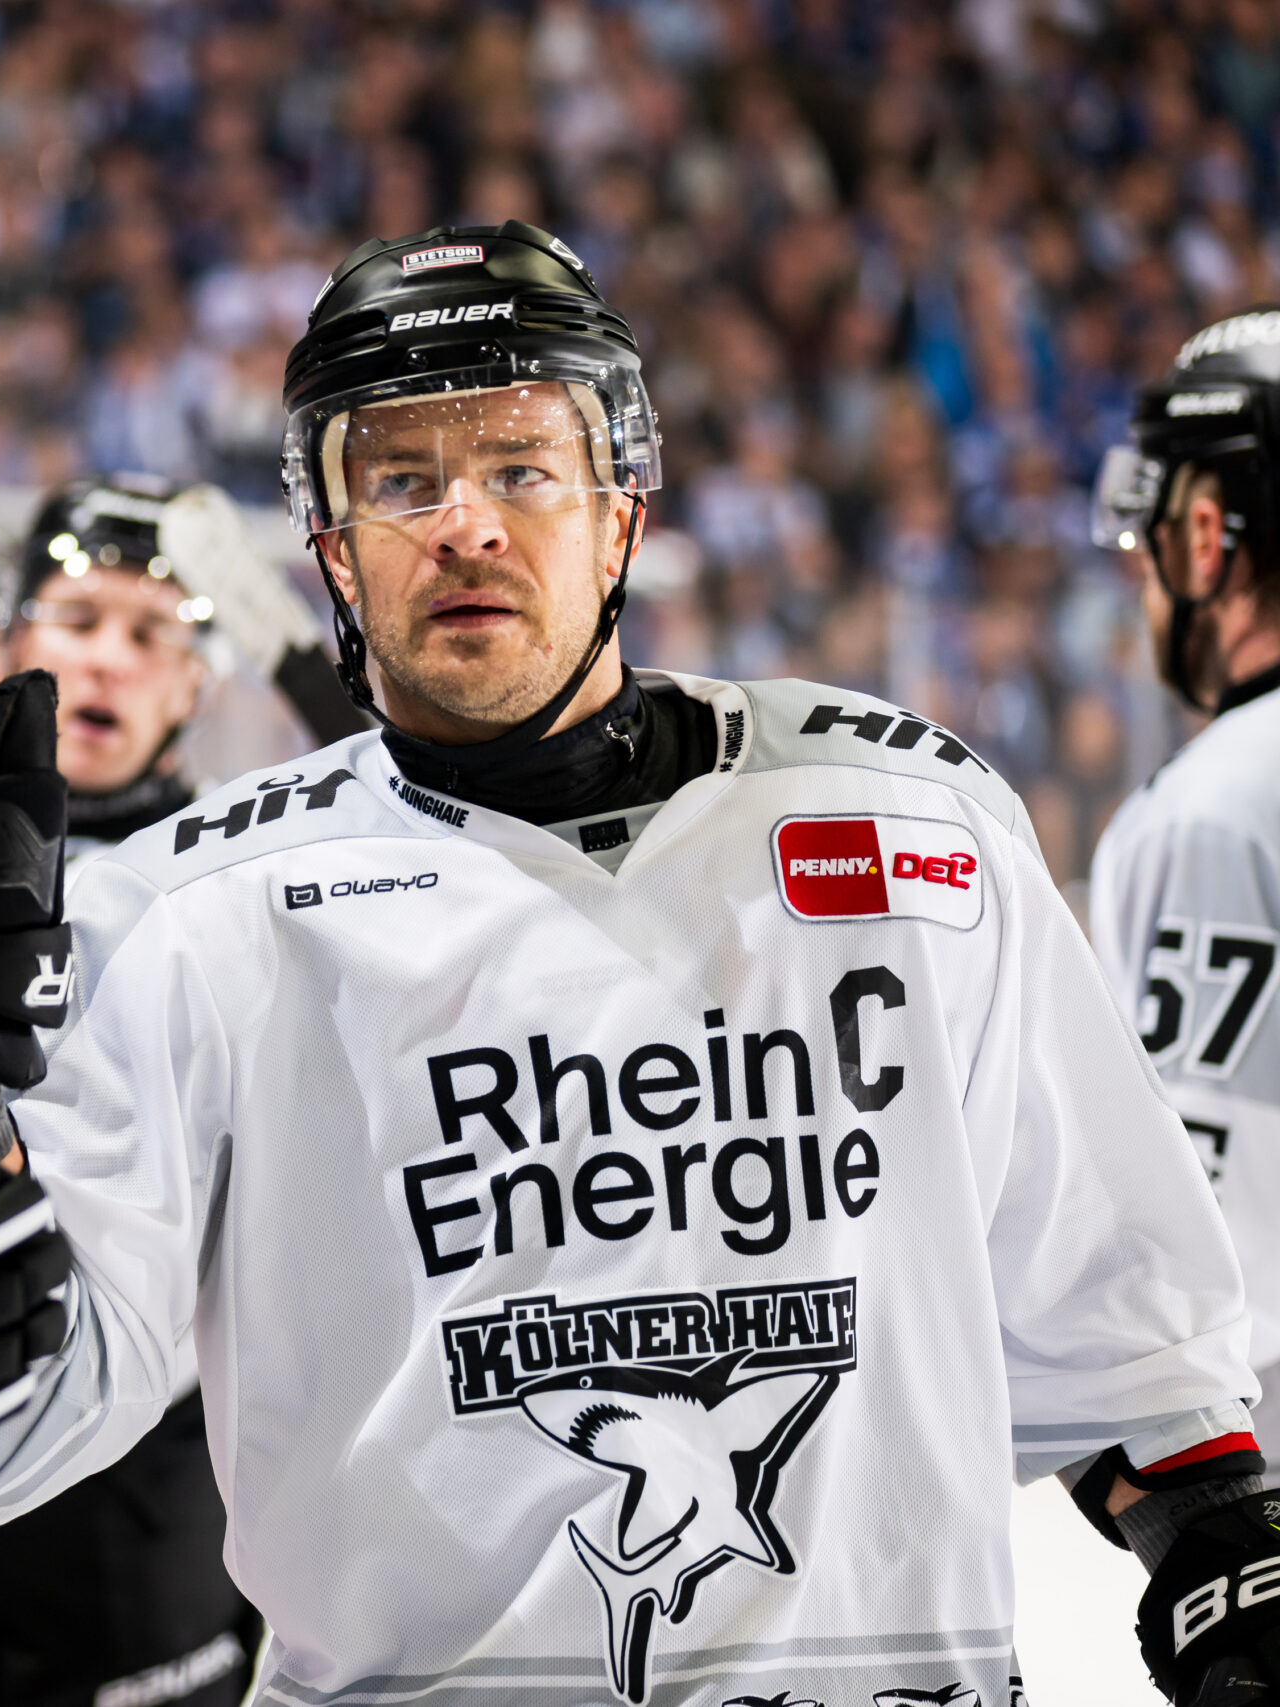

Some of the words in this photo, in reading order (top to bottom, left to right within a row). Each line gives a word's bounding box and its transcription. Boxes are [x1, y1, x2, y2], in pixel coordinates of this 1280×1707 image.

[408, 247, 477, 264] STETSON
[720, 709, 745, 773] #JUNGHAIE
[389, 775, 470, 829] #JUNGHAIE
[427, 1007, 816, 1154] Rhein
[829, 965, 907, 1113] C
[403, 1128, 880, 1278] Energie
[455, 1306, 717, 1402] KÖLNER
